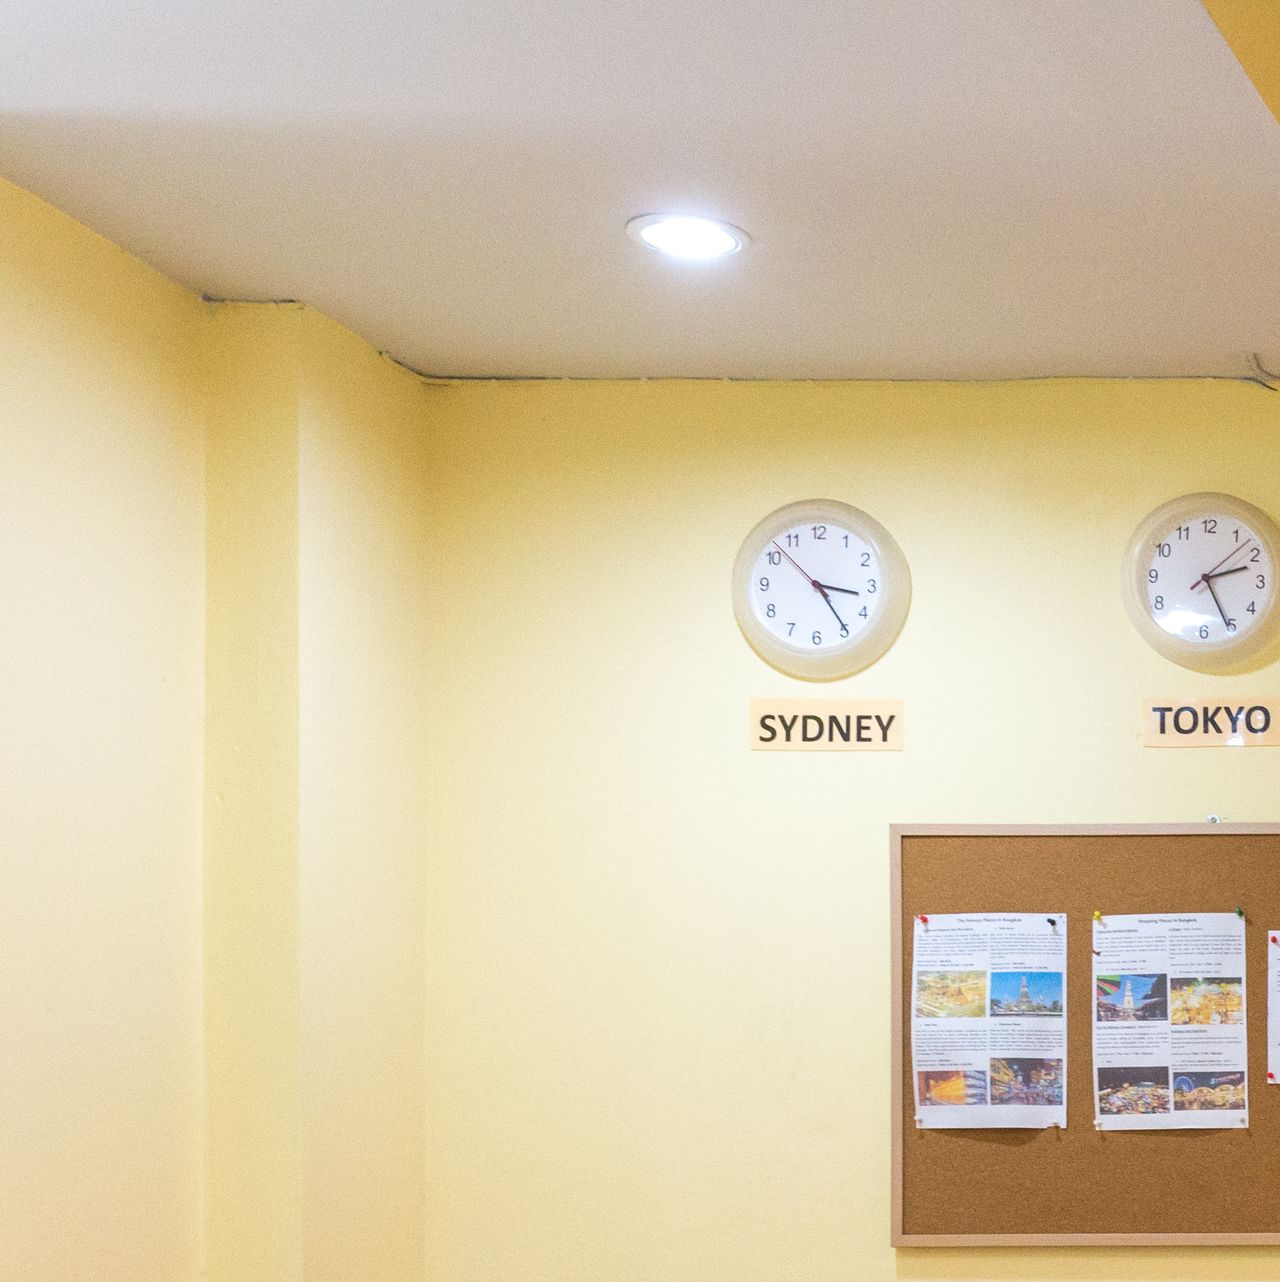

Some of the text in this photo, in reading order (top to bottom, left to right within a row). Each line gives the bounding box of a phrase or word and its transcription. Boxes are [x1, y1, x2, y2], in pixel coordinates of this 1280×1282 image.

[811, 525, 827, 540] 12
[1176, 527, 1189, 540] 11
[1201, 519, 1217, 534] 12
[785, 534, 799, 547] 11
[842, 535, 849, 548] 1
[1233, 529, 1239, 542] 1
[1156, 543, 1171, 558] 10
[1250, 548, 1260, 562] 2
[766, 551, 781, 565] 10
[861, 553, 870, 567] 2
[1149, 569, 1158, 583] 9
[1256, 575, 1266, 589] 3
[759, 577, 769, 591] 9
[867, 579, 877, 593] 3
[766, 604, 776, 618] 8
[858, 606, 868, 619] 4
[1246, 601, 1256, 615] 4
[787, 623, 796, 636] 7
[812, 631, 822, 645] 6
[1152, 705, 1271, 735] TOKYO
[759, 714, 896, 743] SYDNEY
